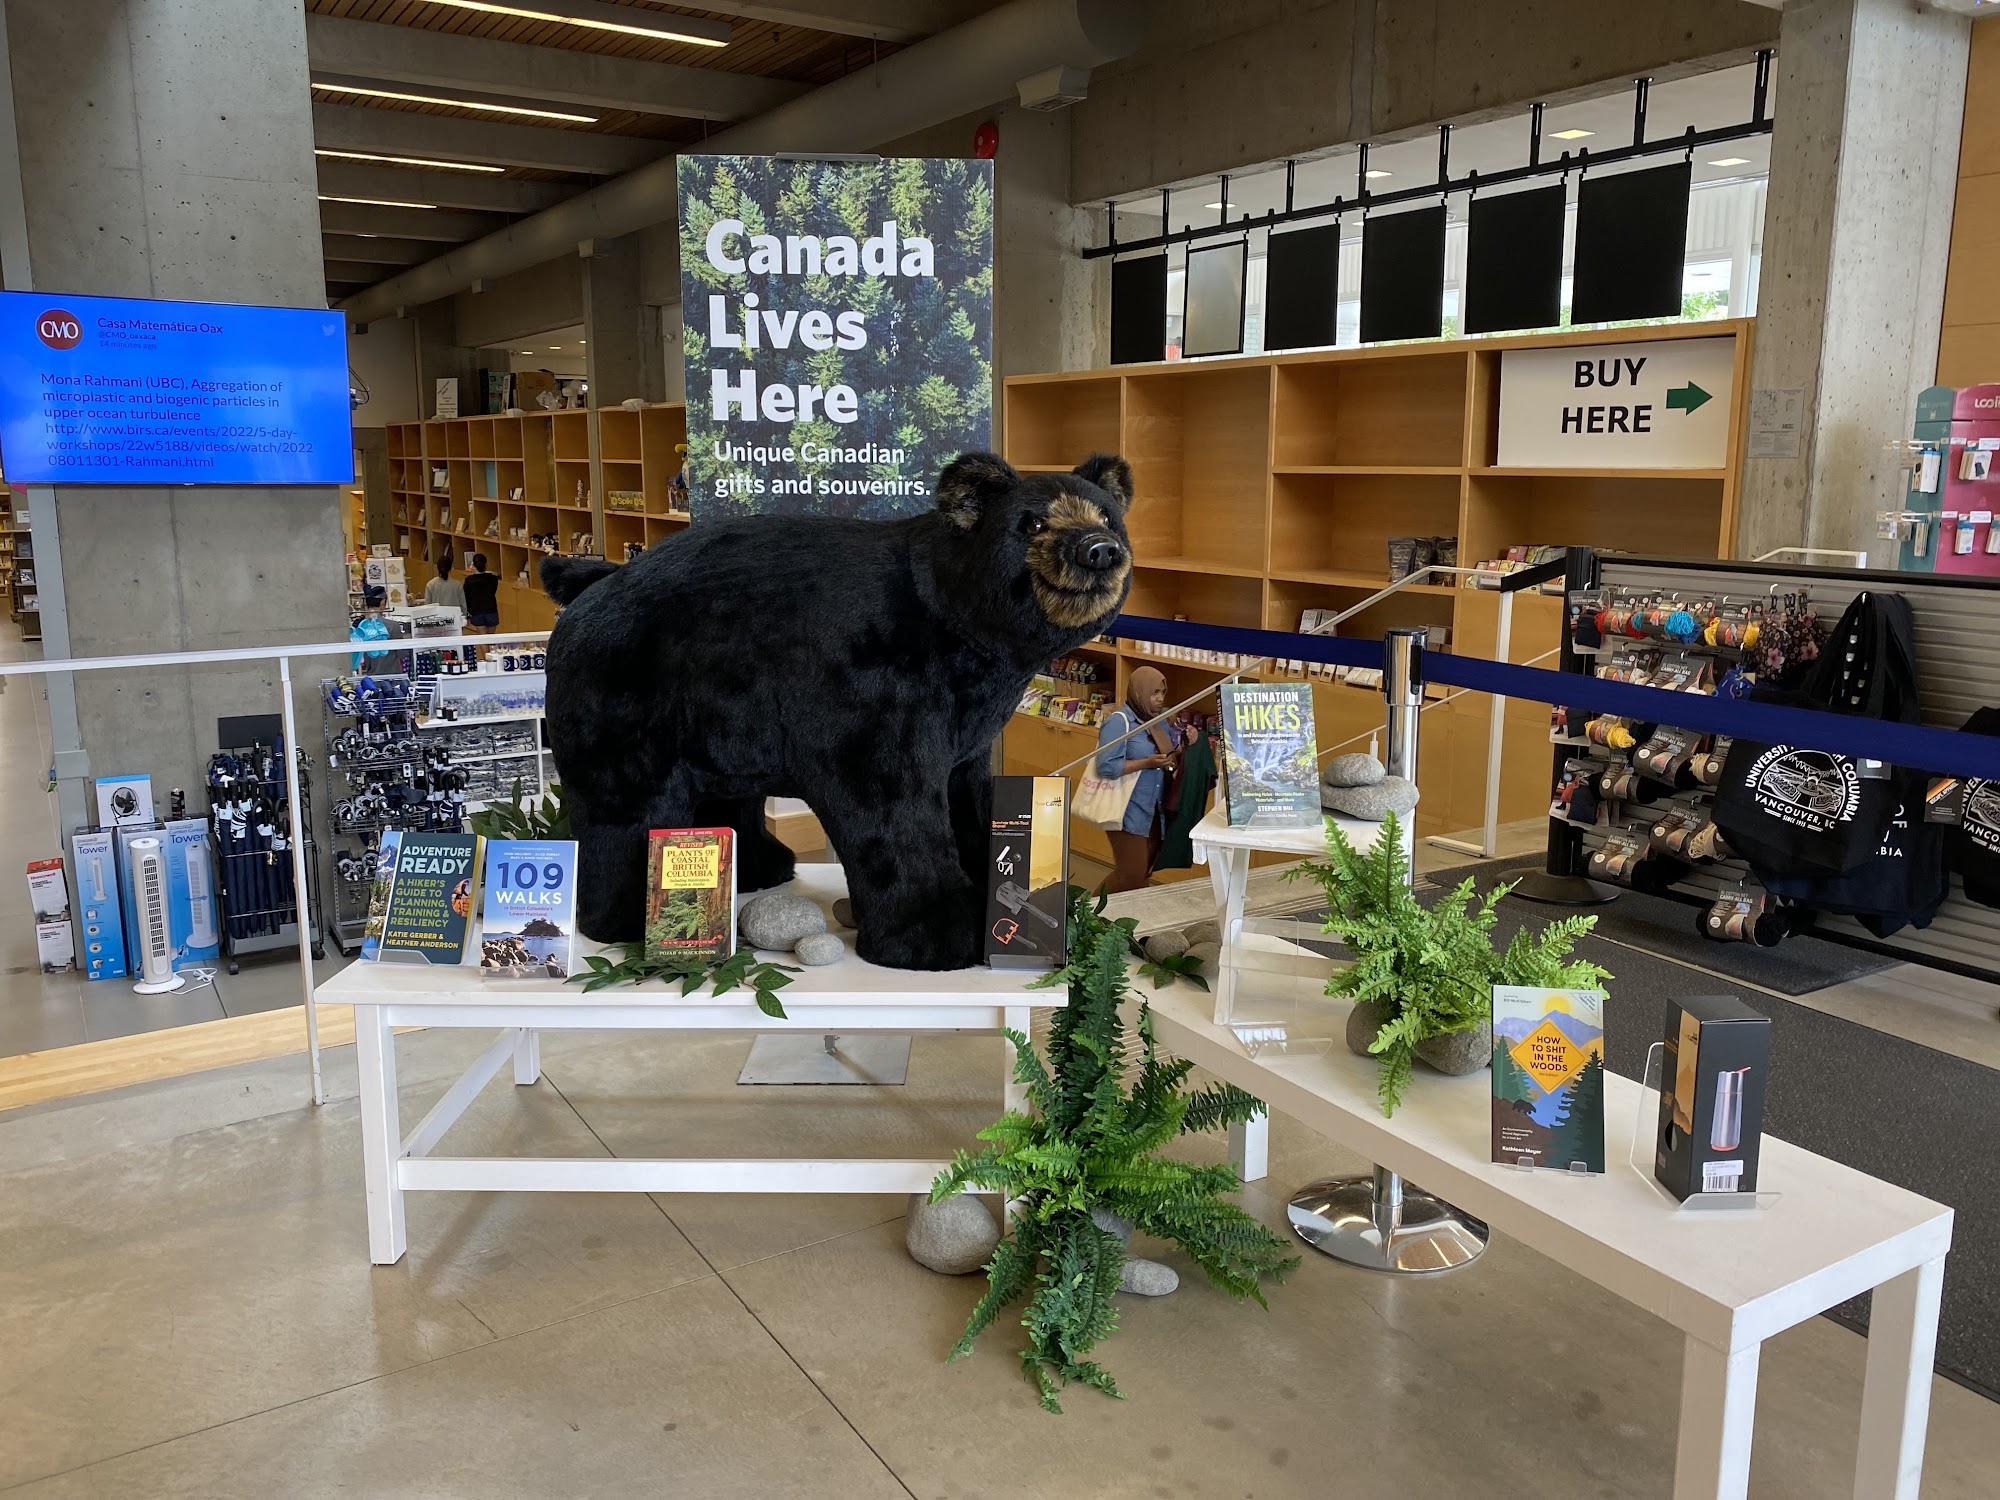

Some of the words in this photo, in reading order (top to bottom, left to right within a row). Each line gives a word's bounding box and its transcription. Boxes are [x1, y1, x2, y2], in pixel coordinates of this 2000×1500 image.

[705, 219, 935, 277] Canada
[98, 318, 127, 329] Casa
[129, 319, 198, 333] Matemática
[200, 323, 223, 334] Oax
[708, 292, 868, 351] Lives
[41, 320, 79, 339] CMO
[111, 341, 141, 349] minutes
[1574, 357, 1647, 388] BUY
[41, 373, 81, 386] Mona
[84, 374, 143, 388] Rahmani
[146, 375, 188, 391] (UBC),
[191, 378, 267, 394] Aggregation
[270, 380, 282, 392] of
[42, 390, 125, 406] microplastic
[128, 392, 152, 404] and
[155, 392, 208, 409] biogenic
[212, 394, 265, 410] particles
[268, 396, 279, 407] in
[711, 368, 859, 424] Here
[44, 409, 84, 421] upper
[87, 409, 127, 419] ocean
[130, 408, 200, 421] turbulence
[1561, 404, 1653, 434] HERE
[45, 422, 298, 440] http://www.birs.ca/events/2022/5-day-
[47, 439, 313, 454] workshops/22w5188/videos/watch/2022
[48, 454, 214, 468] 08011301-Rahmani.html
[715, 441, 794, 471] Unique
[800, 442, 905, 464] Canadian
[714, 475, 765, 497] gifts
[771, 476, 813, 495] and
[818, 476, 931, 496] souvenirs.
[1233, 692, 1299, 703] DESTINATION
[1234, 704, 1301, 730] HIKES
[1675, 740, 1686, 748] BAG
[1839, 763, 1860, 822] COLUMBIA
[1755, 793, 1822, 826] VANCOUVER,
[1824, 819, 1836, 829] BC
[1782, 814, 1795, 824] SINCE
[170, 834, 204, 844] Tower
[1963, 821, 2000, 844] VANCO
[78, 845, 108, 855] Tower
[403, 845, 472, 857] ADVENTURE
[1628, 842, 1639, 850] BAG
[401, 857, 470, 875] READY
[397, 878, 405, 886] A
[406, 878, 446, 888] HIKER'S
[497, 862, 564, 890] 109
[396, 888, 427, 897] GUIDE
[429, 889, 442, 897] TO
[495, 891, 562, 905] WALKS
[394, 897, 448, 909] PLANNING,
[393, 907, 441, 917] TRAINING
[442, 909, 450, 918] &
[390, 917, 449, 928] RESILIENCY
[387, 930, 408, 938] KATIE
[409, 931, 437, 940] GERBER
[386, 939, 419, 947] HEATHER
[419, 941, 459, 949] ANDERSON
[1536, 1035, 1561, 1045] HOW
[1531, 1044, 1543, 1052] TO
[1546, 1045, 1567, 1054] SHIT
[1534, 1053, 1544, 1061] IN
[1546, 1054, 1564, 1063] THE
[1530, 1061, 1568, 1072] WOODS
